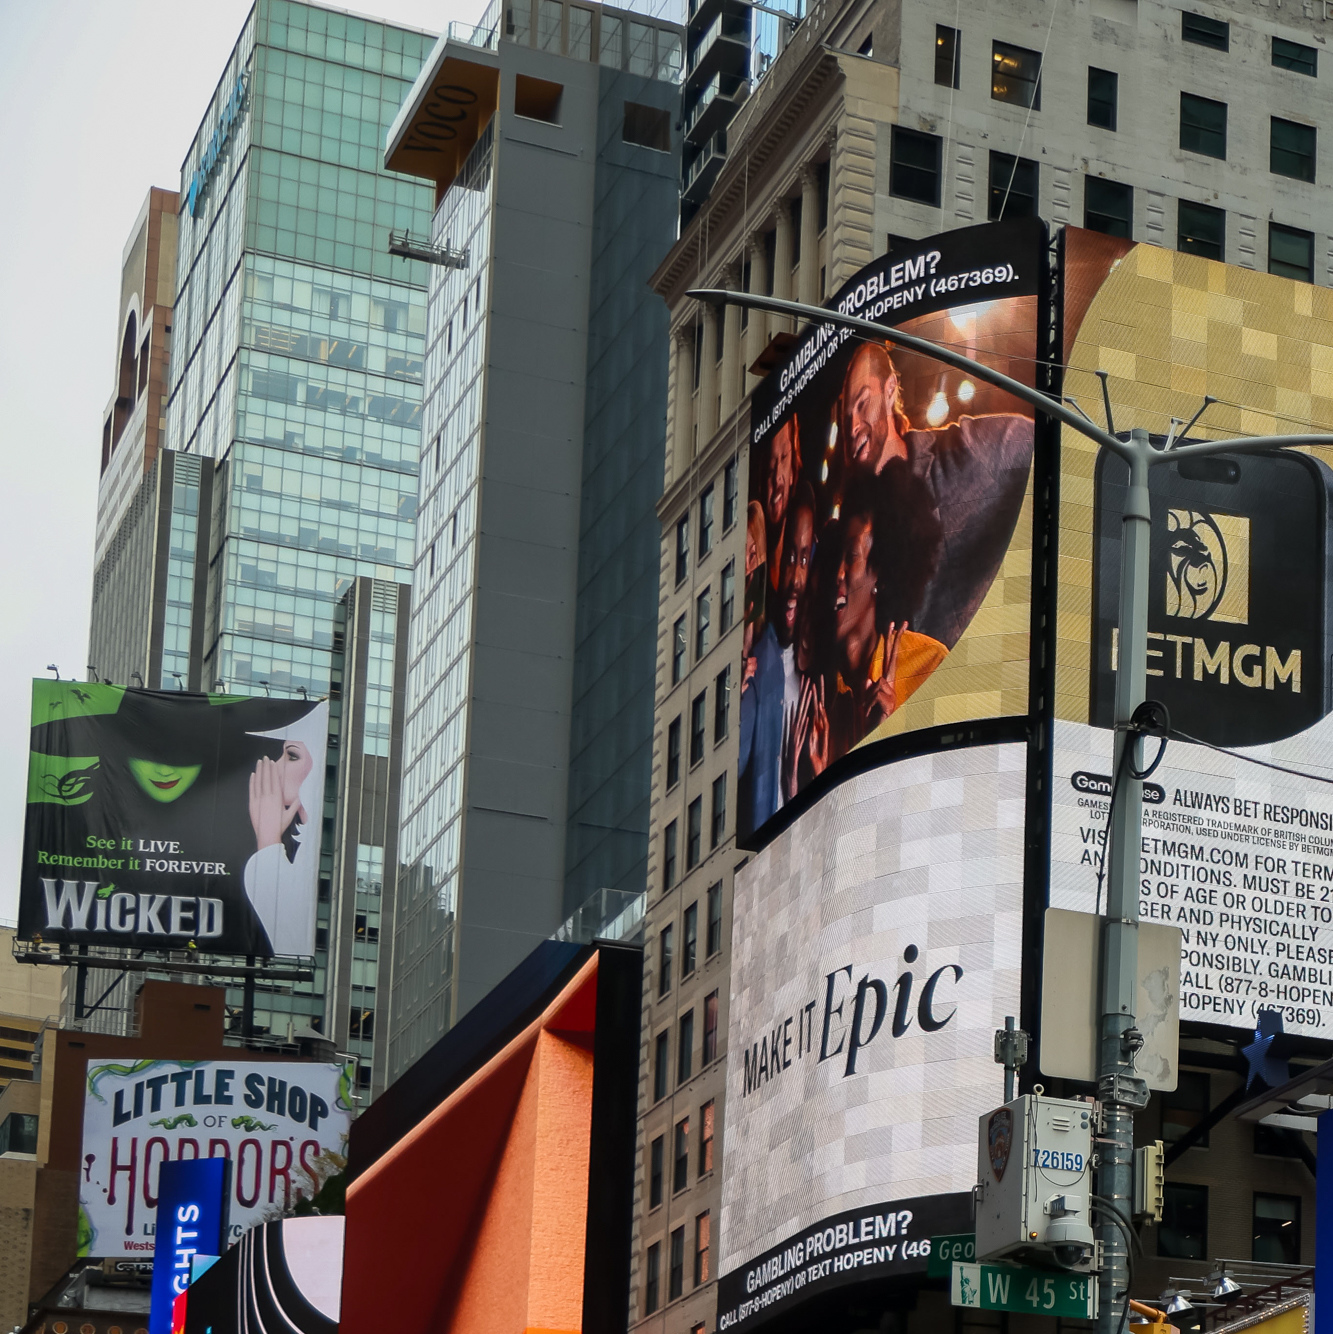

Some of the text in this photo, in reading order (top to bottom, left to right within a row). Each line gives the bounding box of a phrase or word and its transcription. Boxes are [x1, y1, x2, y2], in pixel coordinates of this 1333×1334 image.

[838, 250, 942, 317] PROBLEM?
[754, 263, 1020, 443] CALL OR HOPENY (467369).
[1110, 628, 1303, 694] ETMGM
[1173, 789, 1230, 816] ALWAYS
[1233, 799, 1258, 819] BET
[86, 835, 184, 854] See it LIVE.
[1142, 818, 1194, 836] RPORATION,
[1196, 827, 1219, 840] USED
[1220, 830, 1250, 845] UNDER
[1252, 835, 1285, 849] LICENSE
[1286, 840, 1298, 852] BY
[1151, 811, 1204, 826] REGISTERED
[1206, 817, 1258, 834] TRADEMARK
[1260, 825, 1272, 836] OF
[1274, 827, 1307, 842] BRITISH
[37, 851, 231, 876] Remember it FOREVER.
[1141, 837, 1249, 869] ETMGM.COM
[1255, 854, 1287, 873] FOR
[1138, 857, 1237, 887] ONDITIONS.
[1243, 875, 1290, 898] MUST
[1295, 881, 1315, 901] BE
[1157, 881, 1178, 900] OF
[1184, 887, 1218, 906] AGE
[1223, 892, 1246, 910] OR
[1251, 897, 1306, 920] OLDER
[1313, 905, 1332, 923] TO
[1177, 907, 1319, 943] AND PHYSICALLY
[1180, 949, 1262, 977] PONSIBLY.
[1197, 932, 1220, 949] NY
[1224, 937, 1271, 958] ONLY.
[1180, 971, 1333, 1008] ALL (877-8-HOPEN
[742, 943, 963, 1098] MAKE IT Epic
[112, 1069, 329, 1132] LITTLE SHOP
[203, 1115, 227, 1128] OF
[107, 1136, 321, 1225] HOORS
[746, 1210, 914, 1294] GAMBLING PROBLEM?
[720, 1306, 738, 1331] CALL
[795, 1272, 806, 1291] OR
[807, 1261, 832, 1284] TEXT
[833, 1245, 895, 1273] HOPENY
[987, 1272, 1085, 1309] W 45 St
